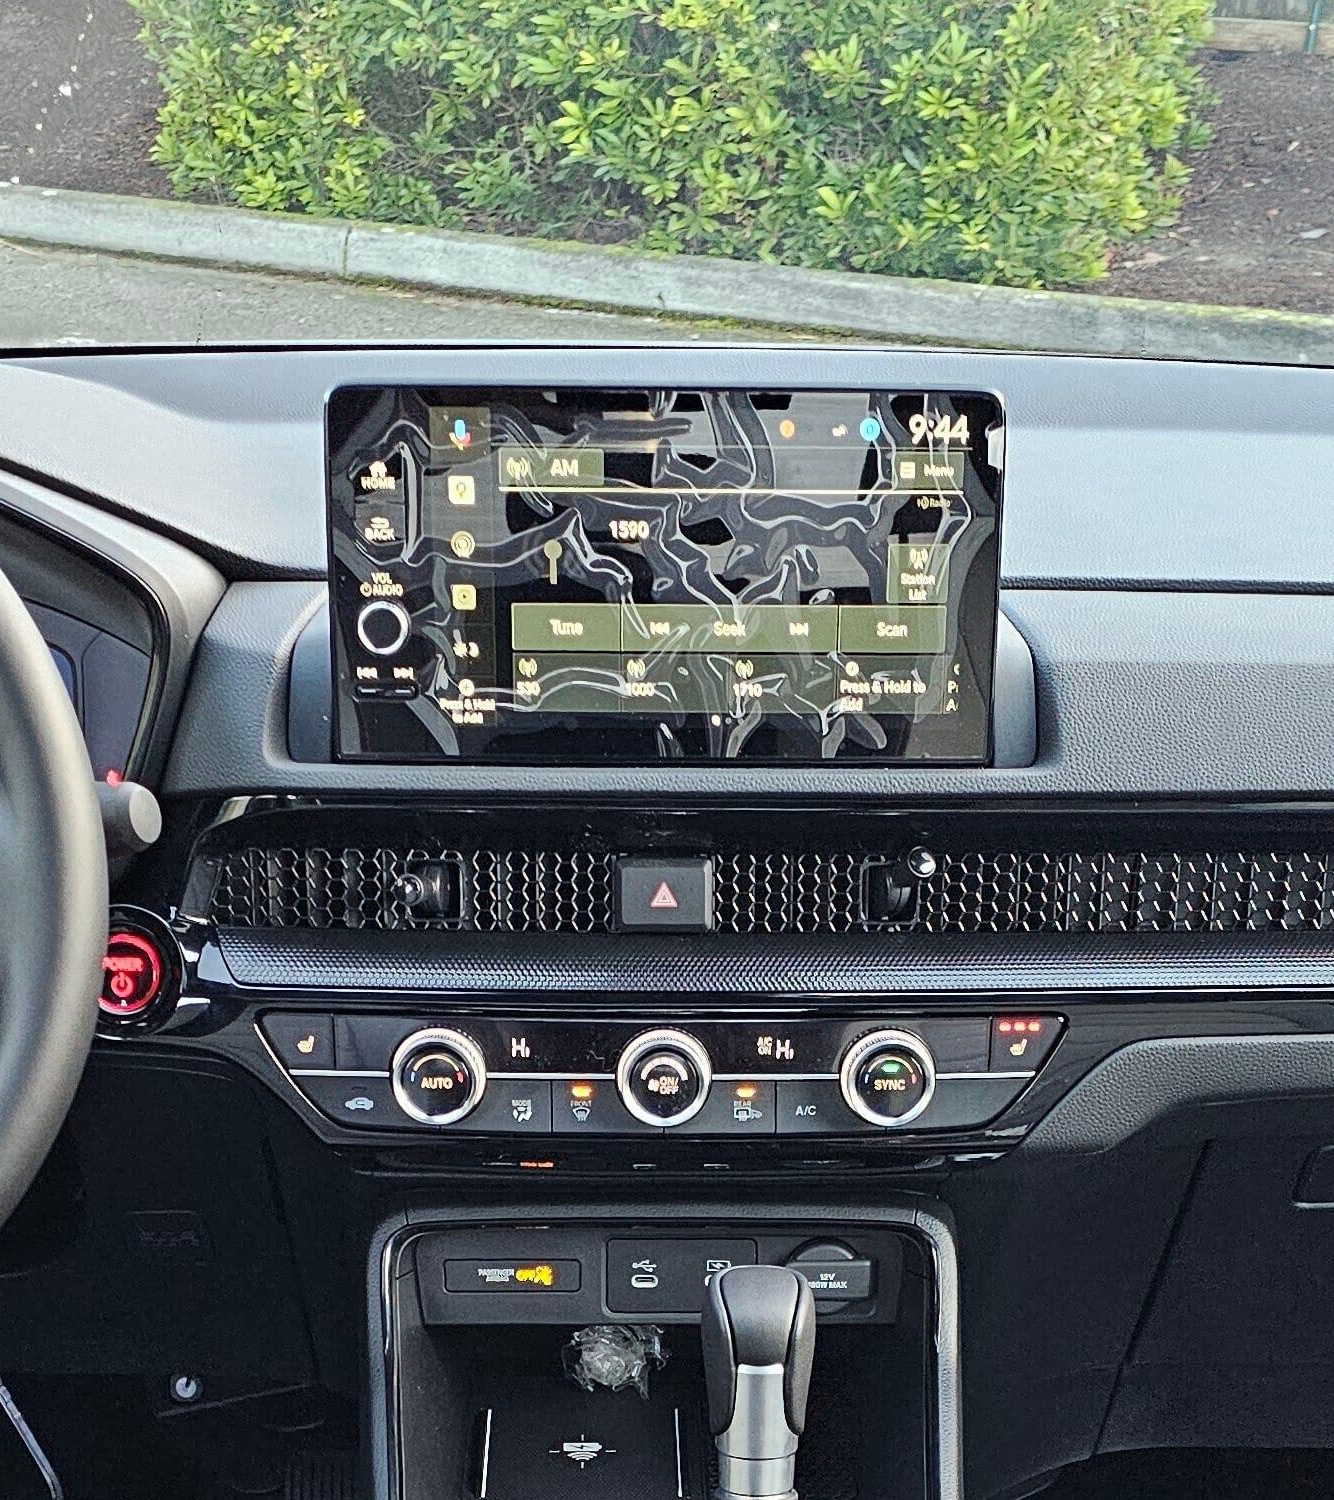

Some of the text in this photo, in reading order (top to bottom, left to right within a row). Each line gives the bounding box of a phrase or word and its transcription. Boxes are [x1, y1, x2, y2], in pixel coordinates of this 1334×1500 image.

[909, 414, 970, 444] 9:44
[550, 459, 579, 477] AM
[361, 476, 395, 490] HOME
[365, 527, 395, 541] BACK
[609, 520, 649, 539] 1590
[371, 572, 393, 585] VOL
[901, 574, 936, 586] Station
[373, 585, 403, 597] AUDIO
[549, 620, 584, 636] Tune
[713, 622, 747, 637] Seek
[876, 622, 908, 637] Scan
[733, 683, 762, 698] 1710
[840, 680, 871, 694] Press
[884, 680, 911, 694] Hold
[913, 681, 926, 694] to
[420, 1077, 453, 1090] AUTO
[659, 1085, 679, 1095] OFF
[873, 1079, 906, 1091] SYNC
[795, 1105, 817, 1116] A/C
[819, 1272, 836, 1281] 12V
[829, 1281, 848, 1289] MAX
